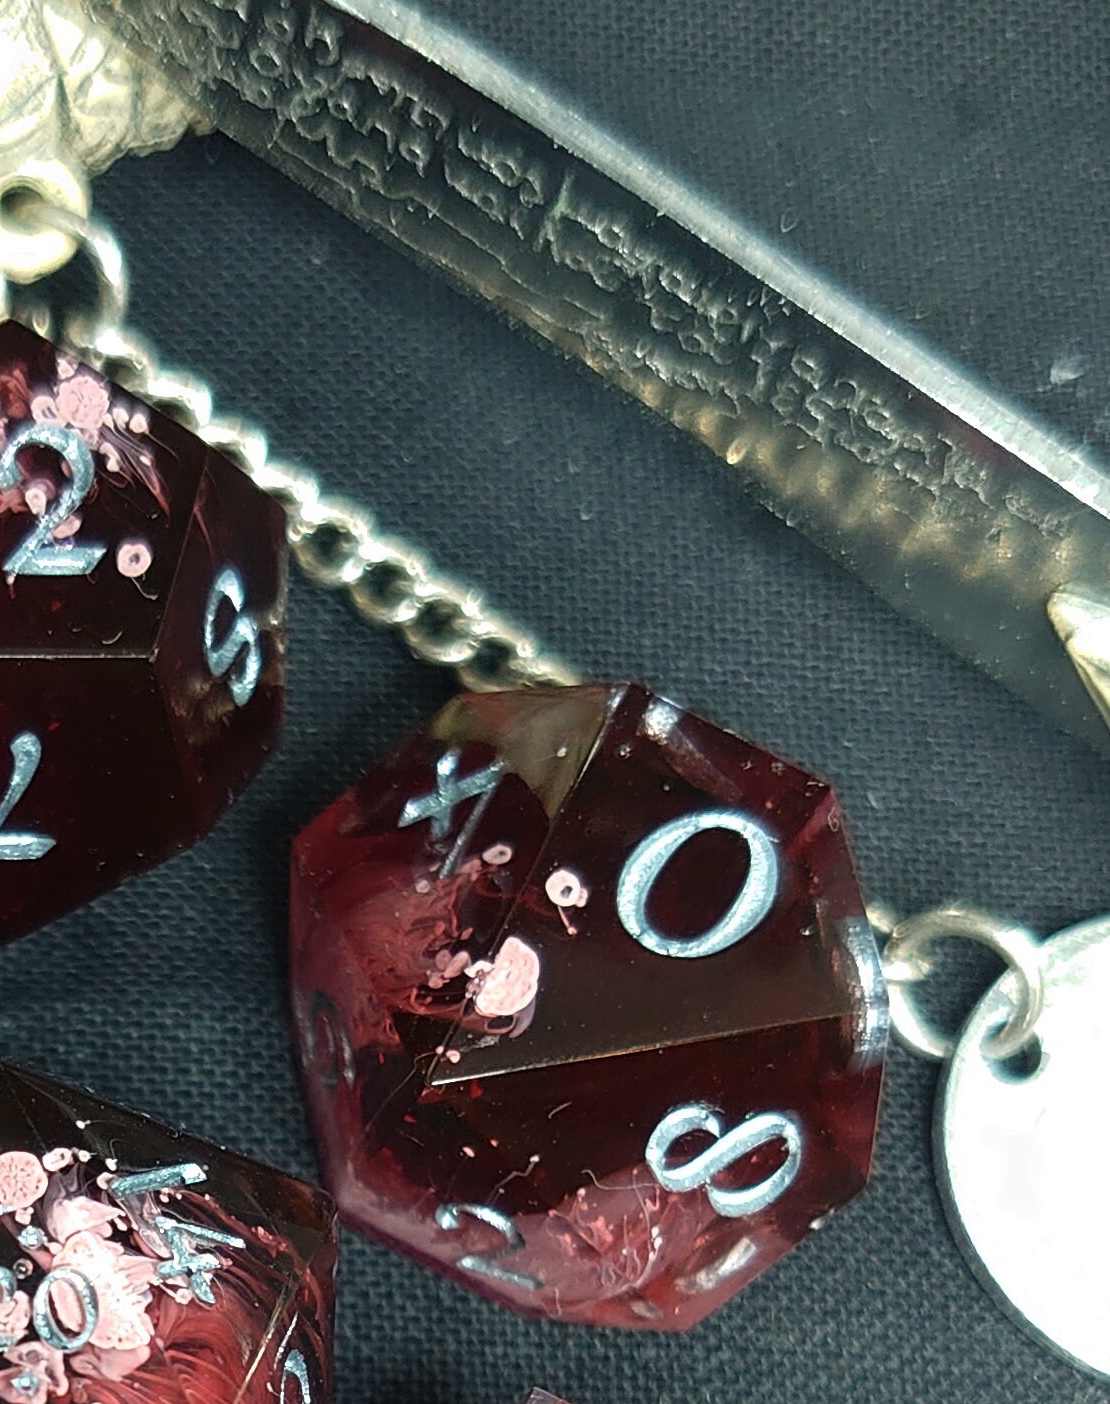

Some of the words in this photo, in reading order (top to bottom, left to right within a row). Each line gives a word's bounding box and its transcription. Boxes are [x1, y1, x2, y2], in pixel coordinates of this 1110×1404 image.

[397, 748, 509, 879] 4
[616, 806, 779, 959] 0
[644, 1101, 803, 1219] 8
[109, 1161, 247, 1305] 14
[435, 1202, 546, 1291] 2
